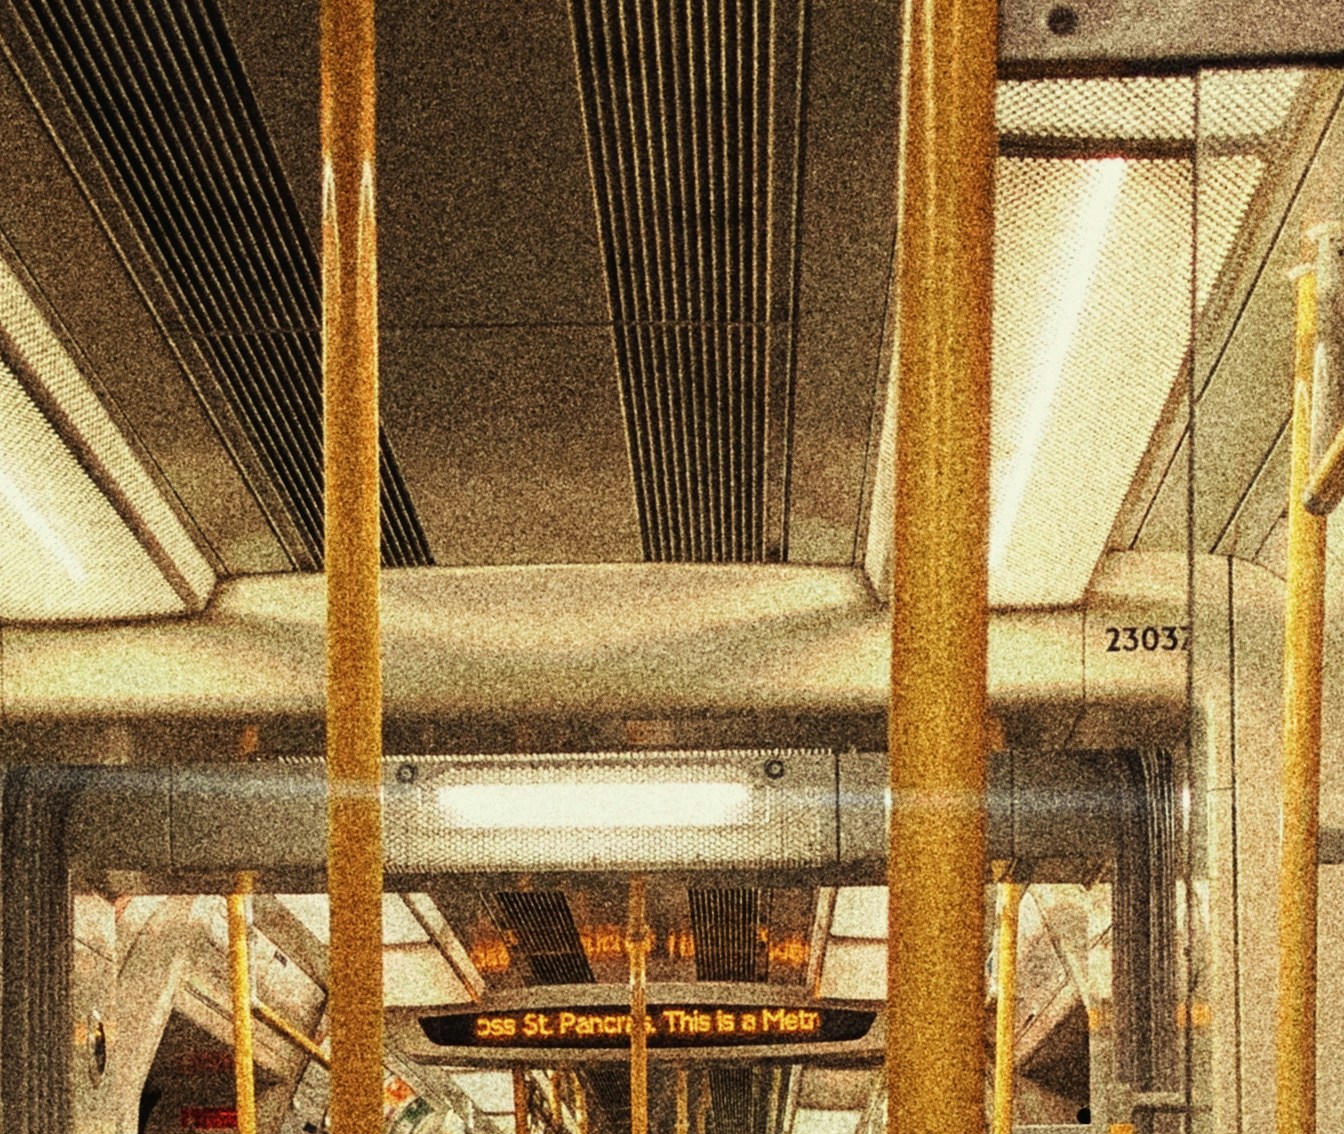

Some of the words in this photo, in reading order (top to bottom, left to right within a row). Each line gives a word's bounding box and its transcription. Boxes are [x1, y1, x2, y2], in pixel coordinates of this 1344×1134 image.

[663, 1009, 711, 1032] This
[716, 1009, 735, 1031] is
[742, 1014, 757, 1031] a
